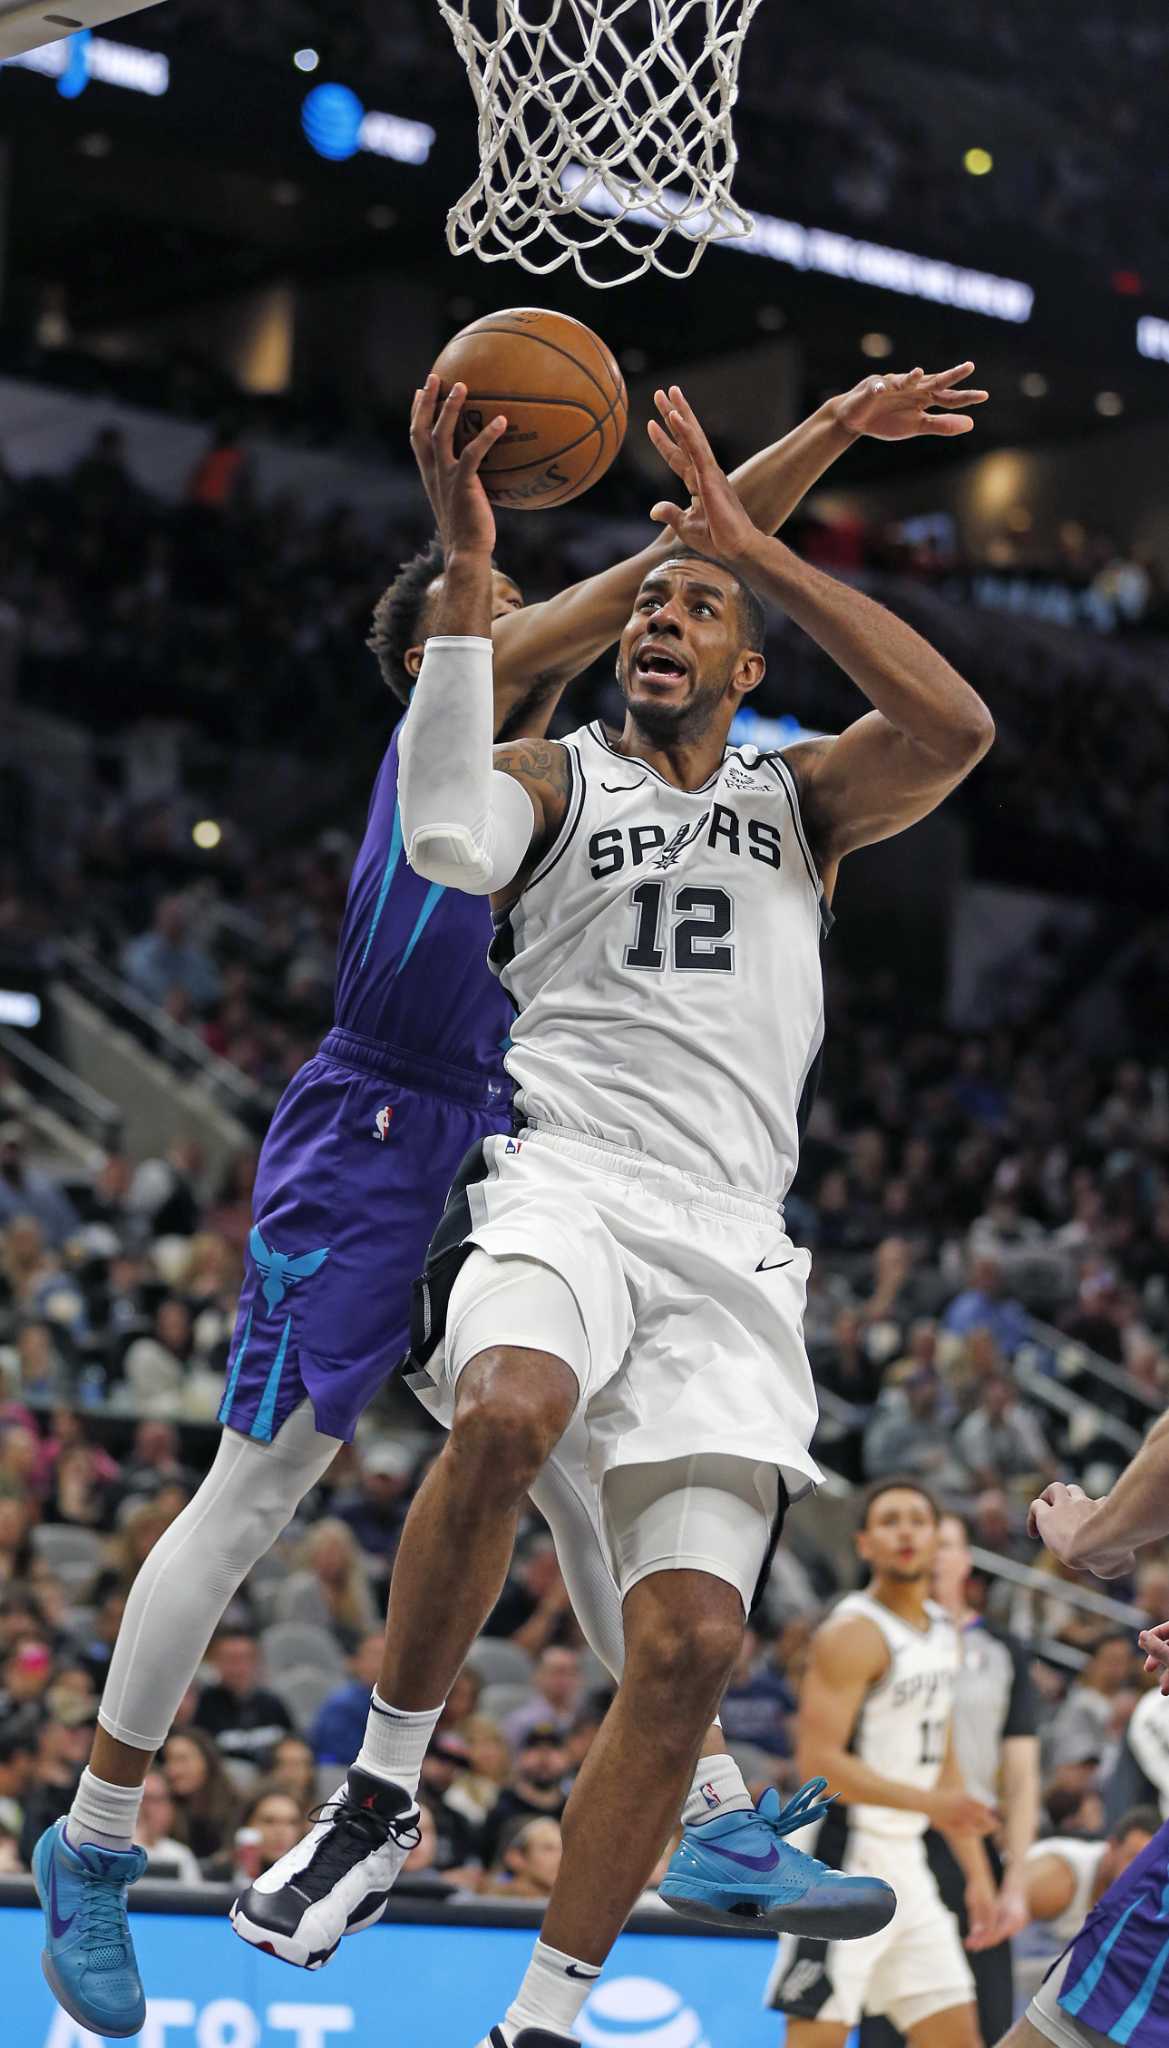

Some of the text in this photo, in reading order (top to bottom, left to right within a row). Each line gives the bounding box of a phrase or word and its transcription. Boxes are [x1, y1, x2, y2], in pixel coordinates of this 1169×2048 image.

[724, 777, 774, 793] Frost
[589, 802, 781, 880] SPURS
[622, 880, 735, 975] 12
